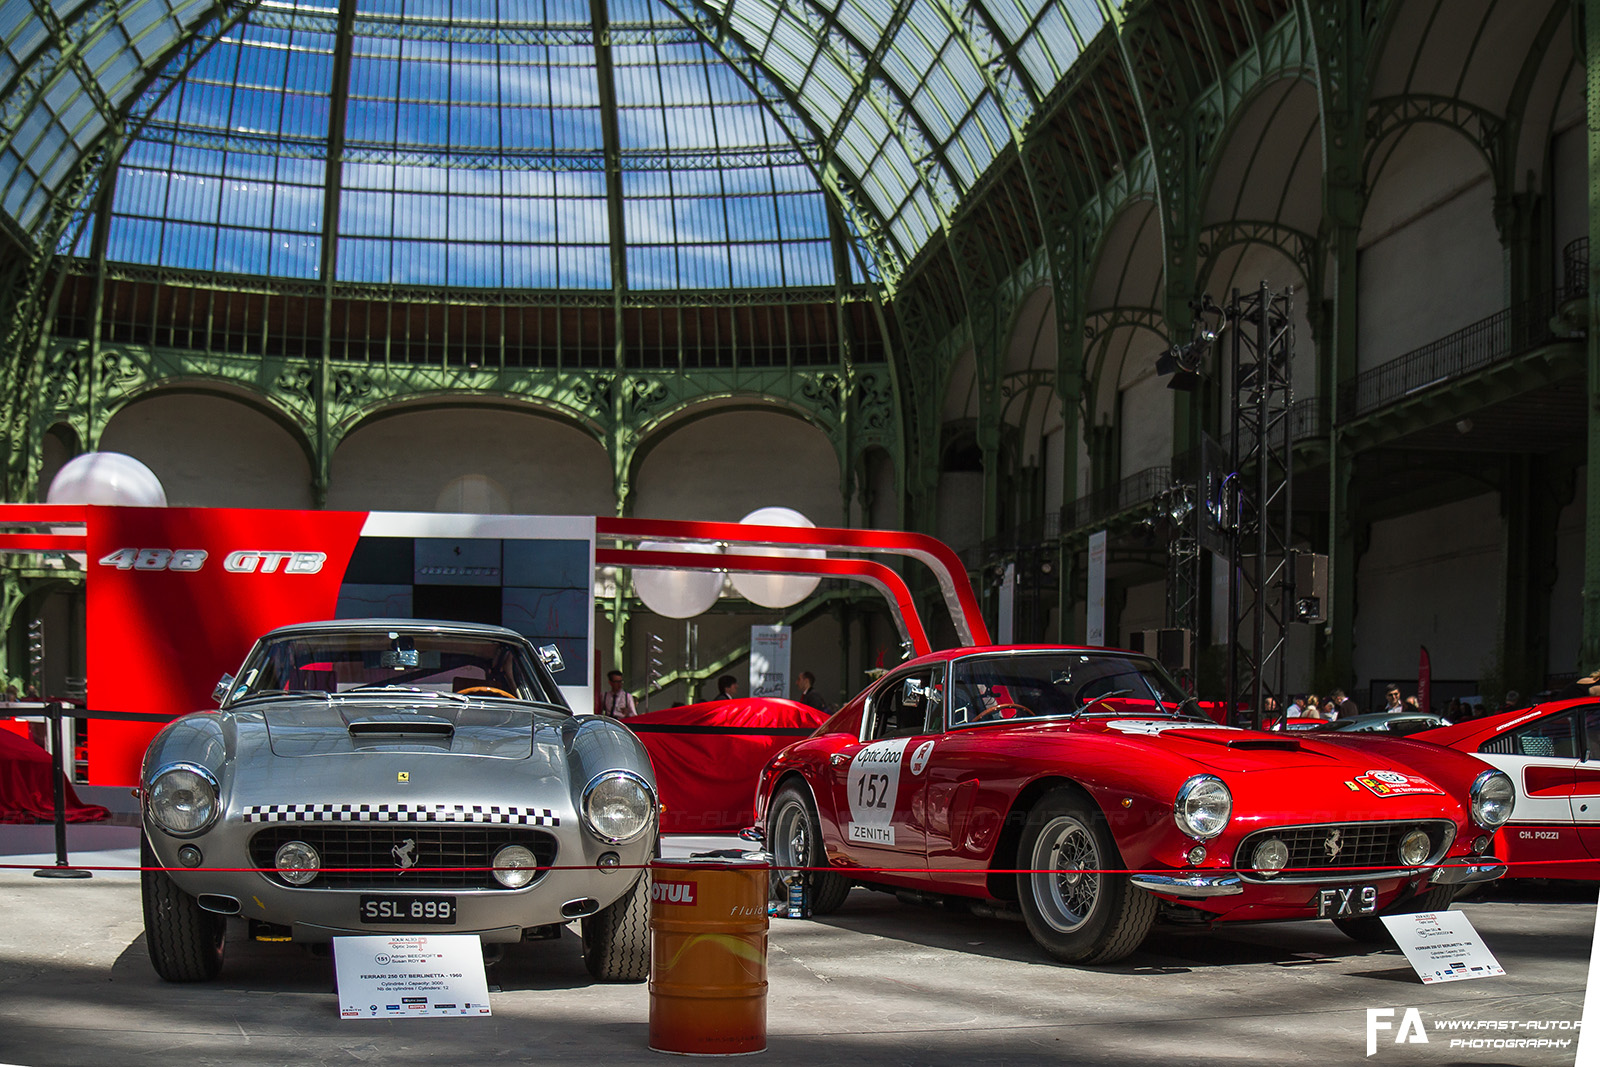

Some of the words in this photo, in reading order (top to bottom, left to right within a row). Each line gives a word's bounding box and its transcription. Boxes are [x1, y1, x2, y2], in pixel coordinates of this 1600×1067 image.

[98, 548, 208, 571] 488
[224, 550, 327, 574] GTB
[858, 748, 880, 767] Optic
[880, 748, 902, 763] 2000
[858, 774, 889, 808] 152
[854, 826, 890, 840] ZENITH
[1519, 831, 1533, 839] CH.
[652, 882, 693, 902] OTUL
[1320, 888, 1354, 916] FX
[1359, 887, 1376, 914] 9
[366, 902, 405, 917] SSL
[411, 902, 450, 918] 899
[730, 905, 767, 915] fluid
